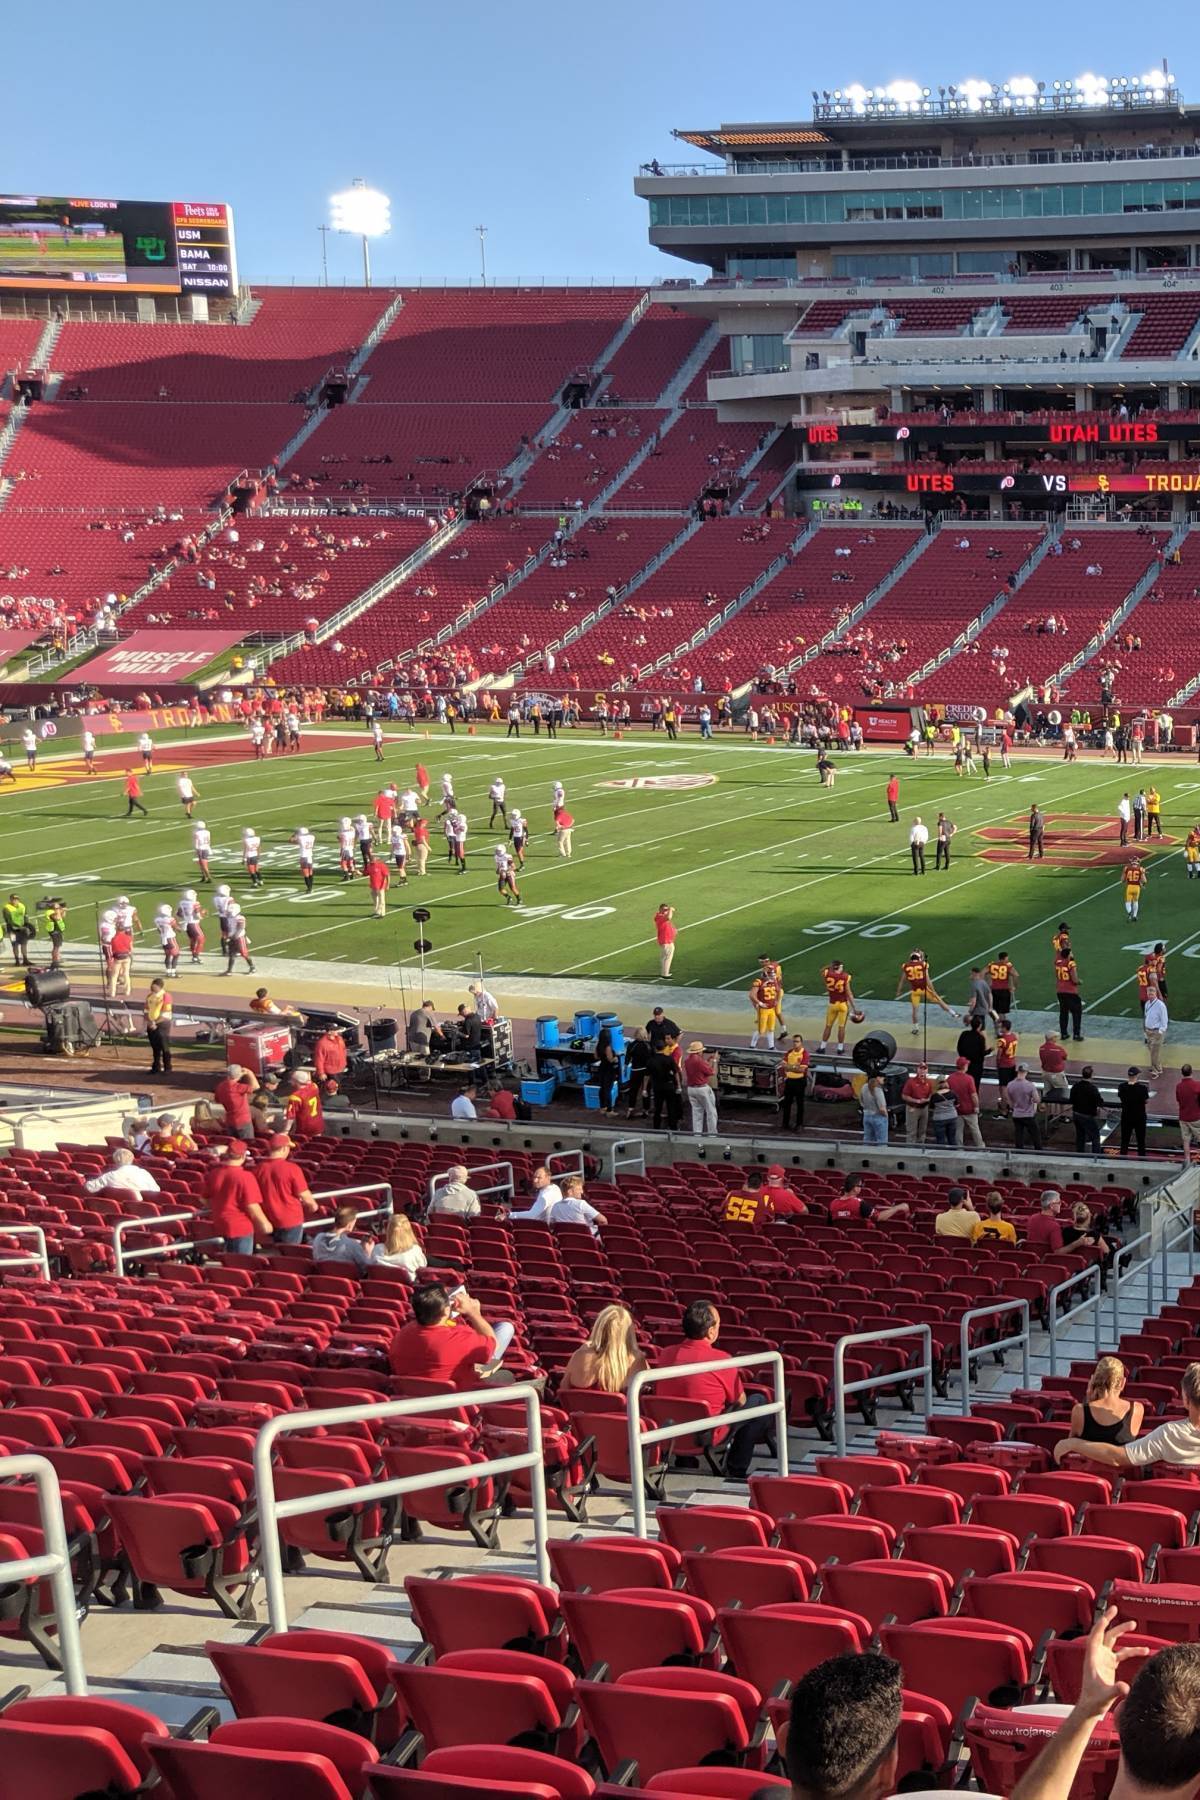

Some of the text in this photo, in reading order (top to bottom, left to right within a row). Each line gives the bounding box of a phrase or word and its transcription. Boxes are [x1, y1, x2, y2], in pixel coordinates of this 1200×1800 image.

[178, 230, 201, 240] USM
[180, 250, 210, 260] BAMA
[183, 277, 229, 288] NISSAN
[809, 425, 839, 443] UTES
[1050, 424, 1158, 442] UTAH UTES
[907, 474, 955, 492] UTES
[1042, 475, 1066, 491] VS
[107, 651, 216, 663] MUSCLE
[115, 661, 181, 675] MILK
[1126, 869, 1140, 882] 46
[801, 920, 911, 938] 50
[905, 965, 924, 981] 36
[990, 964, 1008, 980] 58
[827, 977, 844, 993] 24
[726, 1197, 758, 1223] 55
